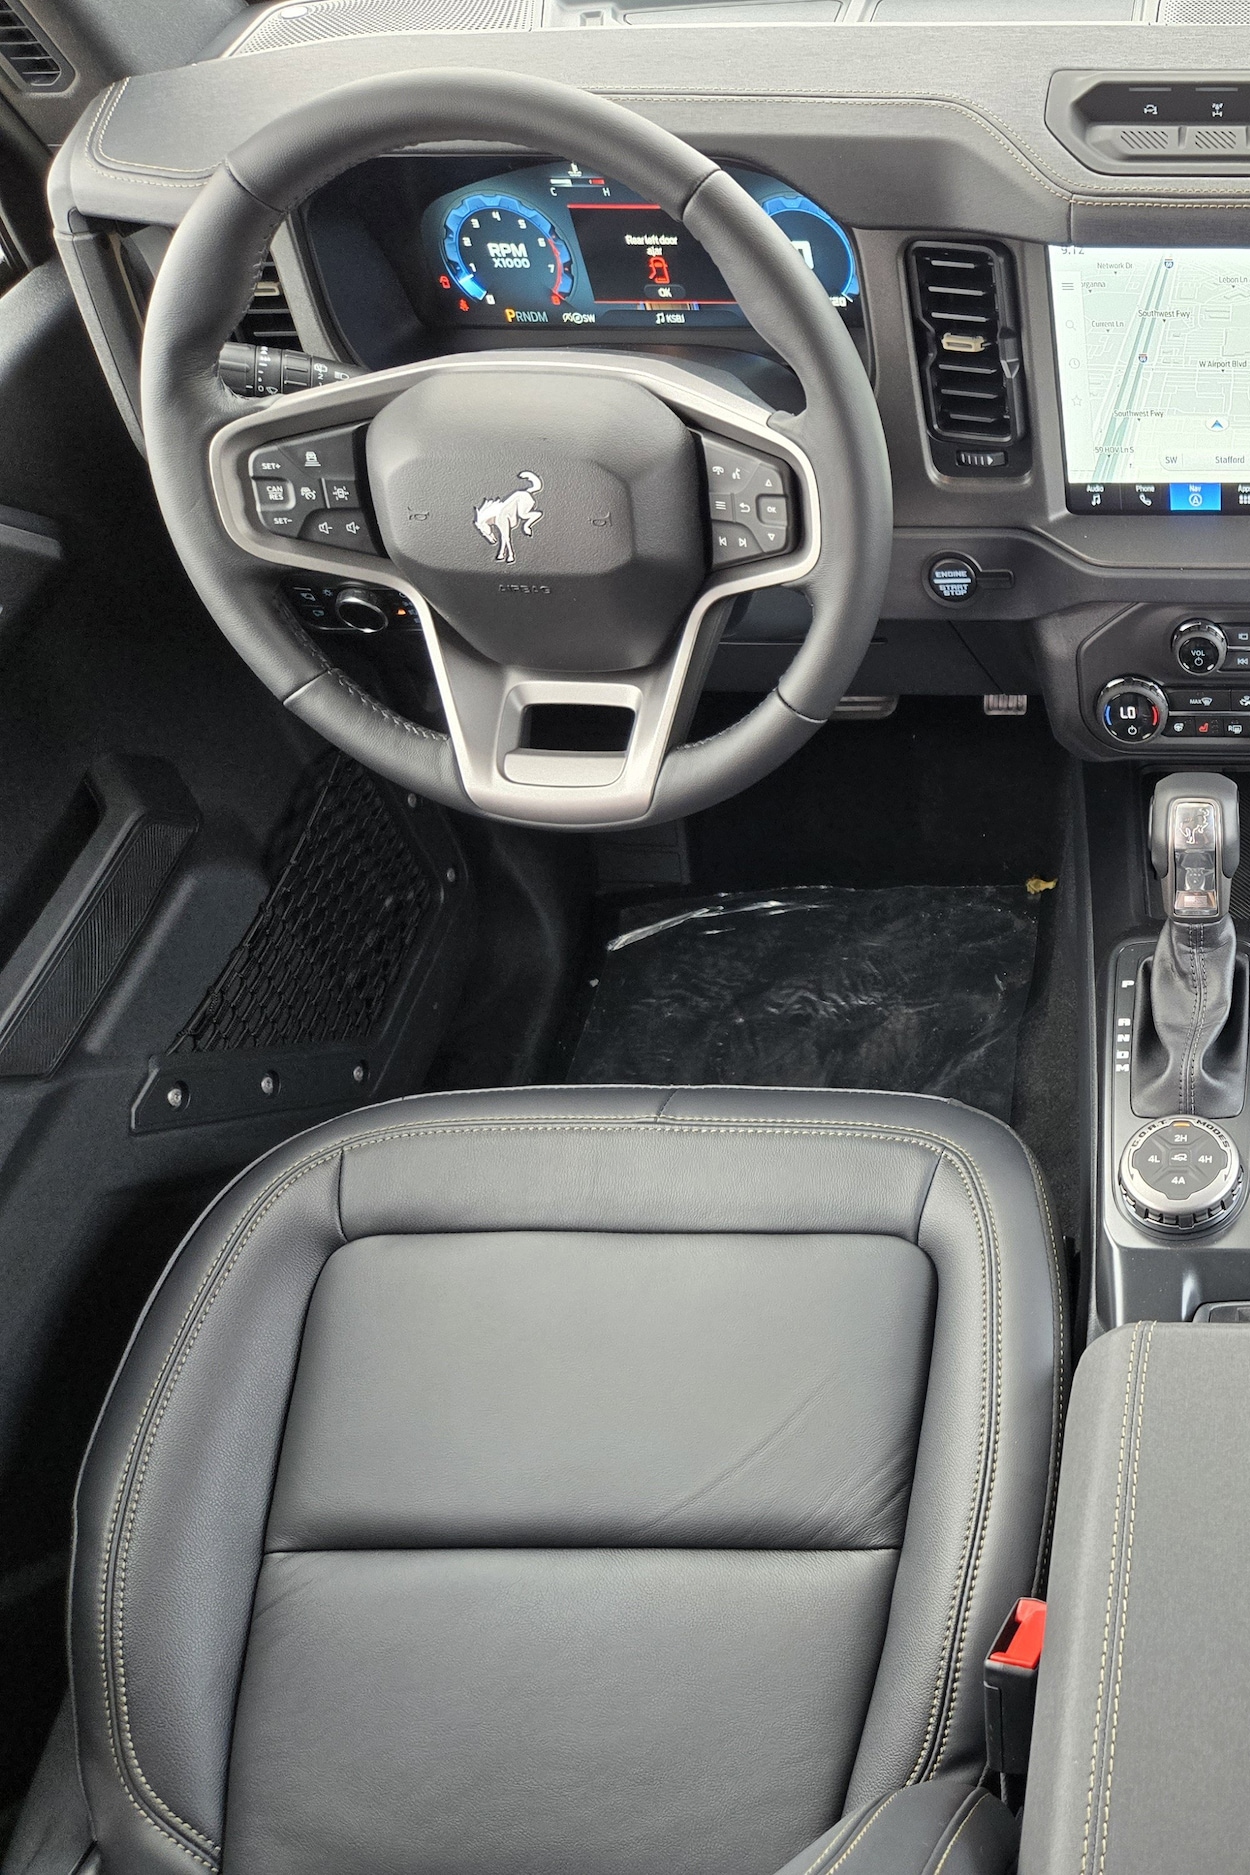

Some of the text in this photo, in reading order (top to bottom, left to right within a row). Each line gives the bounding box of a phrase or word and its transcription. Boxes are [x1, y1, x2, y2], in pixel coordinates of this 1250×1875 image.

[550, 187, 610, 197] C H
[492, 211, 501, 221] 4
[471, 218, 480, 228] 3
[518, 219, 527, 229] 5
[462, 237, 472, 247] 2
[538, 238, 546, 247] 6
[625, 234, 678, 246] Rear left door
[487, 243, 528, 258] RPM
[469, 263, 477, 273] 1
[548, 264, 555, 273] 7
[658, 288, 673, 298] OK
[485, 294, 496, 305] 0
[666, 313, 685, 323] KSBJ
[1138, 310, 1191, 319] Southwest Fwy
[1207, 360, 1230, 369] Airport
[1231, 360, 1247, 368] Blvd
[1150, 410, 1164, 419] Fwy
[1215, 455, 1245, 464] Stafford
[261, 462, 281, 470] SET+
[1086, 485, 1105, 493] Audio
[1135, 485, 1155, 493] Phone
[1189, 485, 1202, 493] Nav
[935, 570, 968, 578] ENGINE
[1119, 706, 1137, 719] LO
[1121, 980, 1135, 988] P
[1118, 1018, 1131, 1027] R
[1117, 1034, 1130, 1042] N
[1116, 1050, 1129, 1059] D
[1115, 1064, 1130, 1072] M
[1174, 1134, 1188, 1142] 2H
[1196, 1119, 1231, 1148] MODES
[1147, 1155, 1161, 1163] 4L
[1198, 1155, 1213, 1163] 4H
[1171, 1176, 1186, 1185] 4A
